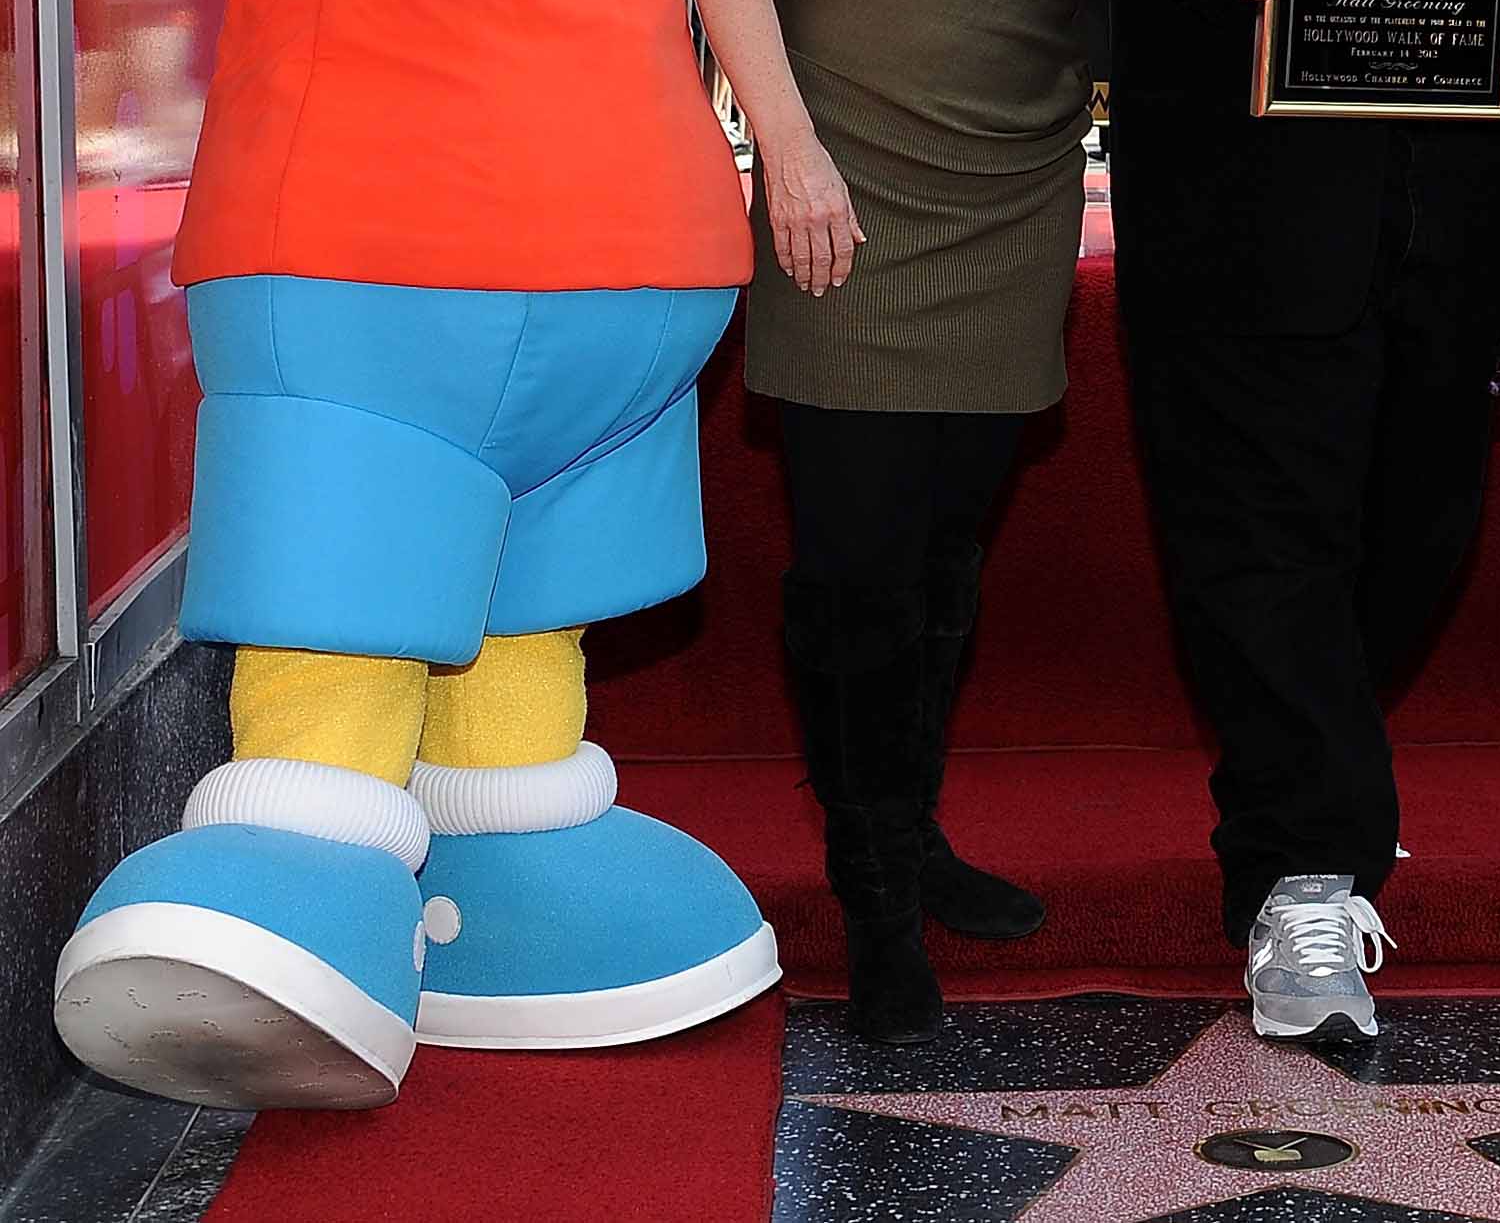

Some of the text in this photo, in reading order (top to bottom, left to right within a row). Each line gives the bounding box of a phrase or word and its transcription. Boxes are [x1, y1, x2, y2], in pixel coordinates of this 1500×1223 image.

[1303, 28, 1485, 47] HOLLYWOOD WALK OF FAME
[1001, 1101, 1168, 1120] MATT
